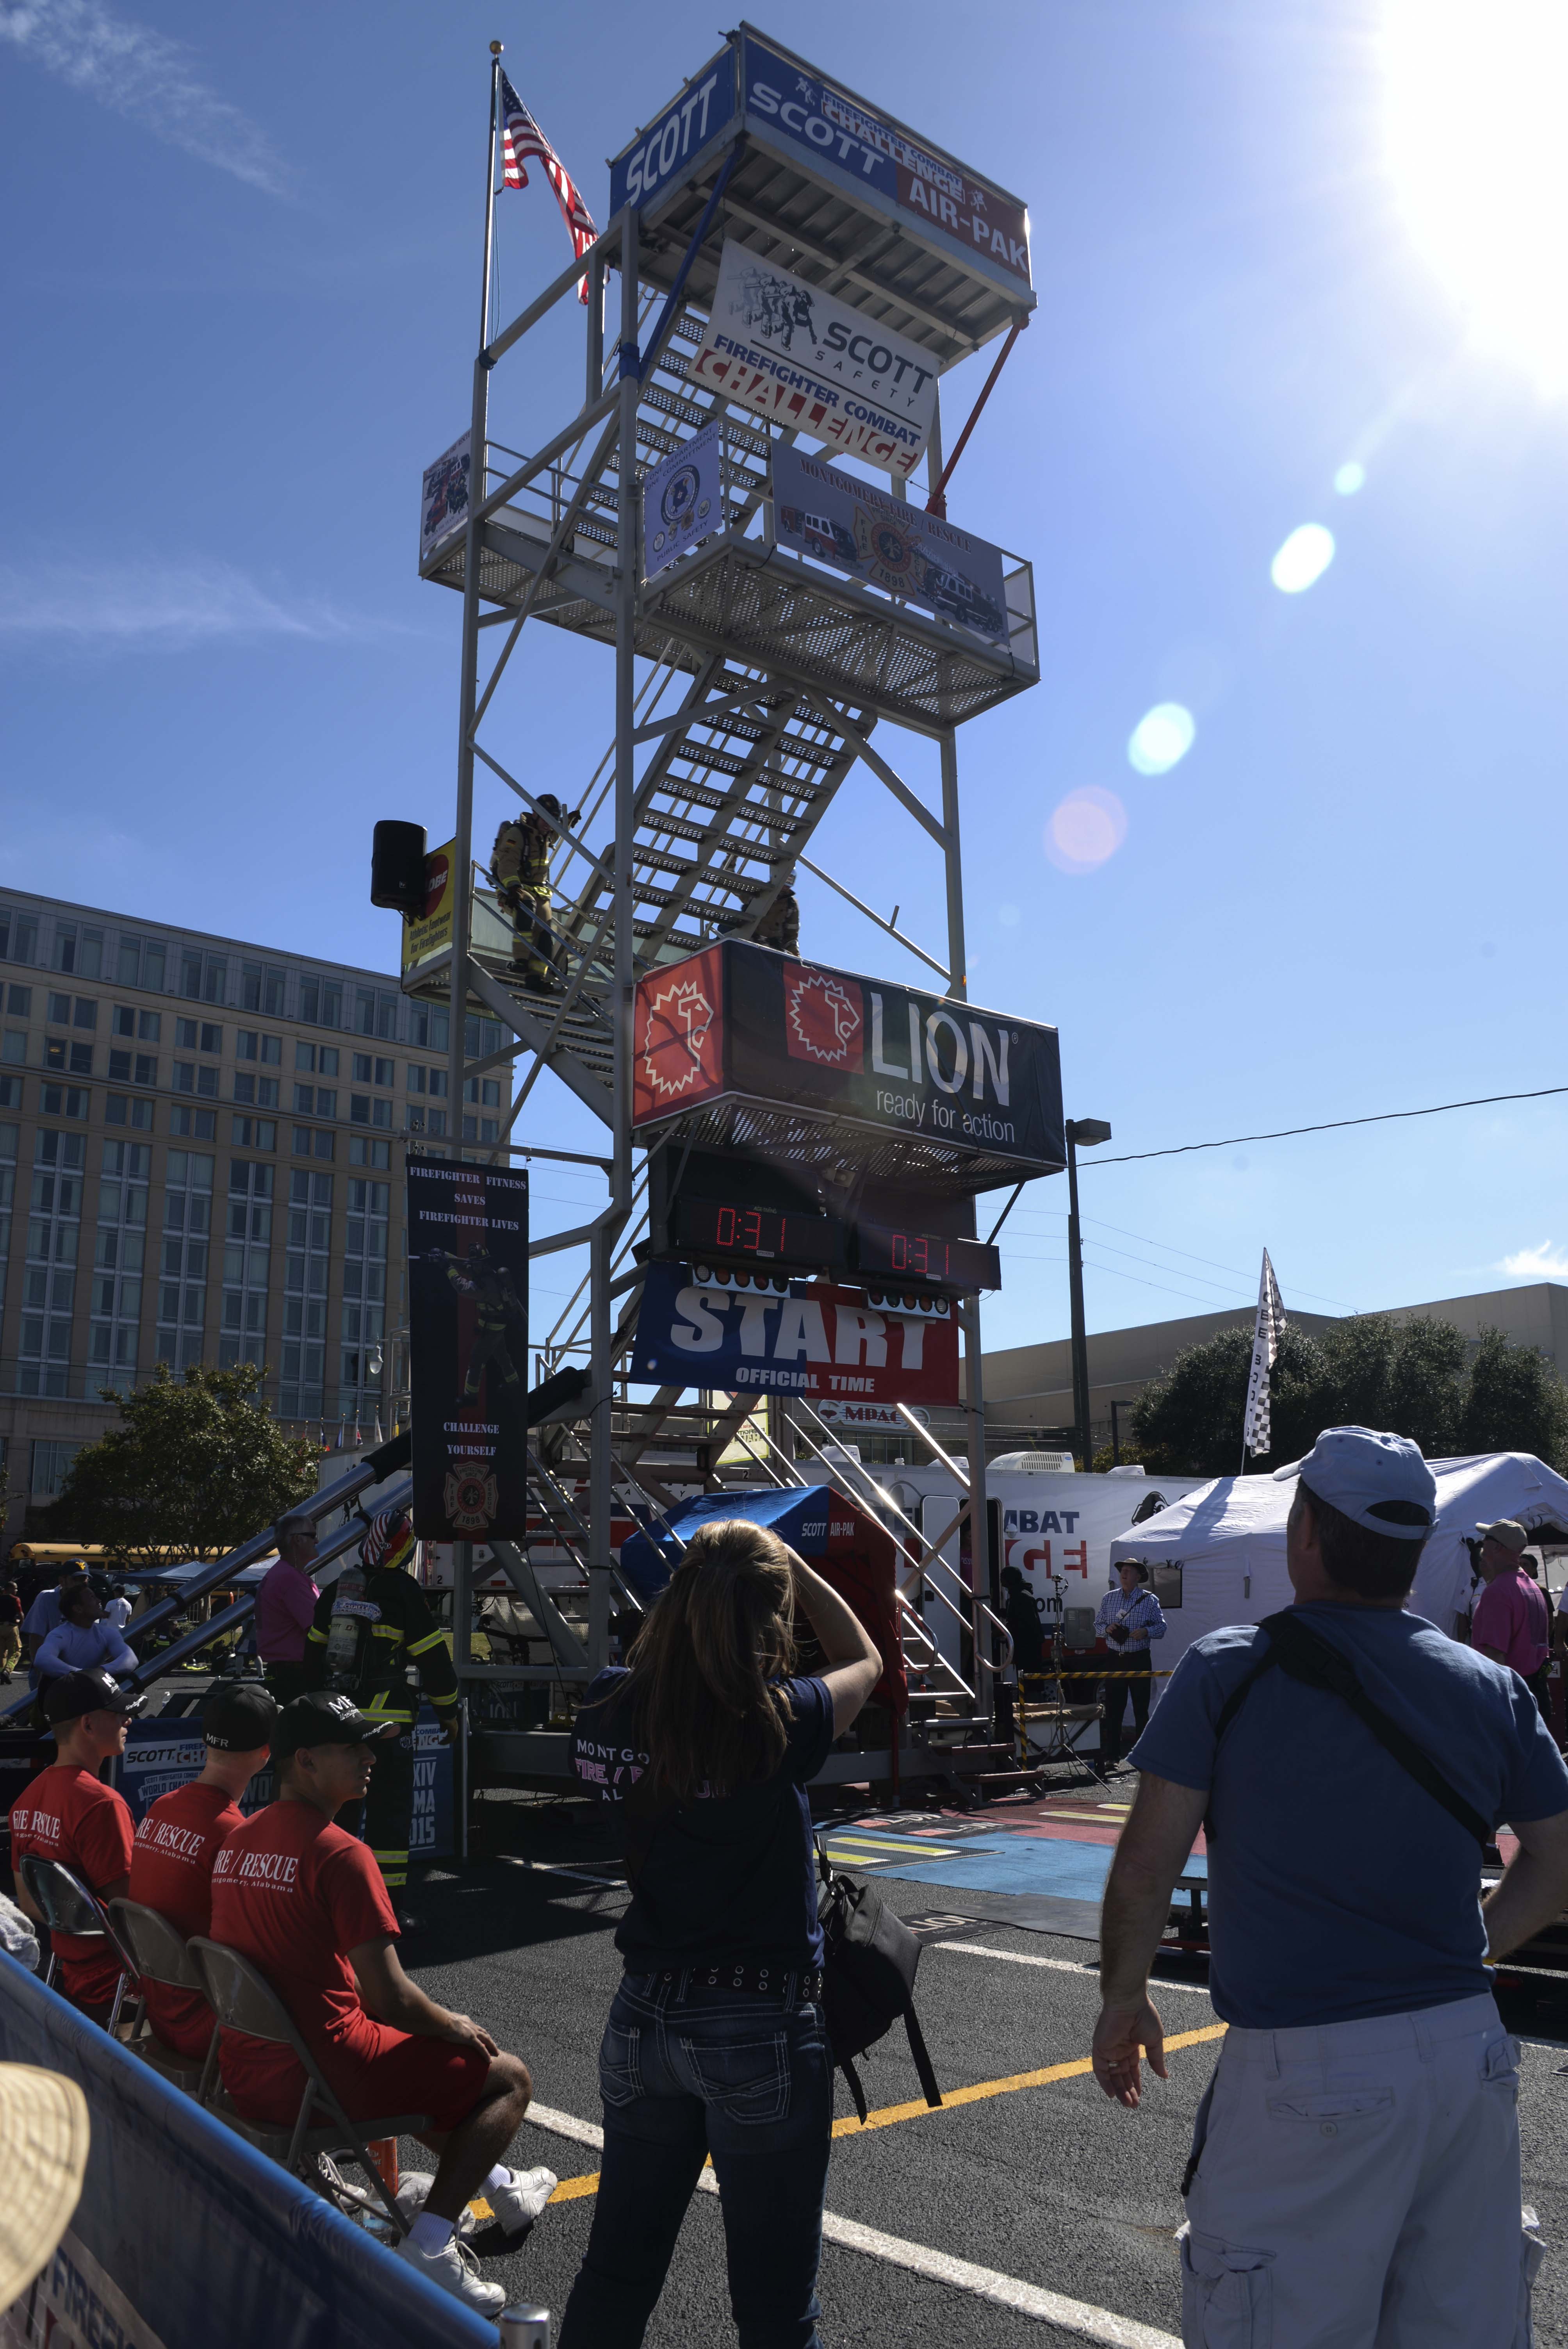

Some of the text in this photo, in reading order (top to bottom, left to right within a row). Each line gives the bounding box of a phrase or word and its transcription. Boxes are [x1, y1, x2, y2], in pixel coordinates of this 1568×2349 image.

[624, 73, 717, 205] SCOTT
[749, 82, 884, 174] SCOTT
[823, 93, 962, 187] FIREFIGHTER COMBAT
[822, 102, 965, 202] CHALLENGE
[909, 177, 1028, 273] AIR-PAK
[822, 322, 934, 394] SCOTT
[714, 334, 921, 447] FIREFIGHTER COMBAT
[695, 349, 918, 472] CHALLENGE
[650, 428, 713, 480] ONE DEPARTMENT
[646, 478, 659, 491] ONE
[799, 459, 885, 510] MONTGOMERY
[890, 502, 917, 528] FIRE
[927, 522, 971, 554] RESCUE
[657, 521, 708, 561] PUBLIC SAFETY
[880, 568, 905, 588] 1898
[428, 870, 448, 893] OBE
[409, 911, 451, 941] Athletic Footwear
[411, 942, 419, 954] for
[870, 993, 1010, 1107] LION
[877, 1090, 1015, 1142] ready for action
[410, 1166, 527, 1190] FIREFIGHTER FITNESS
[454, 1193, 486, 1205] SAVES
[419, 1210, 519, 1231] FIREFIGHTER LIVES
[716, 1207, 786, 1252] 0:31
[891, 1234, 949, 1275] 0:31
[670, 1287, 936, 1370] START
[736, 1367, 875, 1393] OFFICIAL TIME
[444, 1422, 499, 1434] CHALLENGE
[447, 1444, 497, 1456] YOURSELF
[460, 1466, 483, 1475] PROTECTING
[743, 1470, 748, 1479] 2
[462, 1516, 480, 1525] 1898
[801, 1522, 855, 1537] SCOTT AIR-PAK
[437, 1575, 443, 1584] 2
[328, 1696, 356, 1715] MF
[206, 1733, 228, 1747] MFR
[577, 1739, 650, 1764] MONTGO
[127, 1748, 176, 1763] SCOTT
[575, 1757, 609, 1785] FIRE
[141, 1783, 166, 1797] WORLD
[874, 1814, 942, 1823] LION
[936, 1822, 1006, 1832] LION
[153, 1823, 206, 1856] RESCUE
[160, 1849, 196, 1864] Alabama
[213, 1850, 234, 1874] IRE
[239, 1852, 299, 1883] RESCUE
[251, 1881, 293, 1893] Alabama
